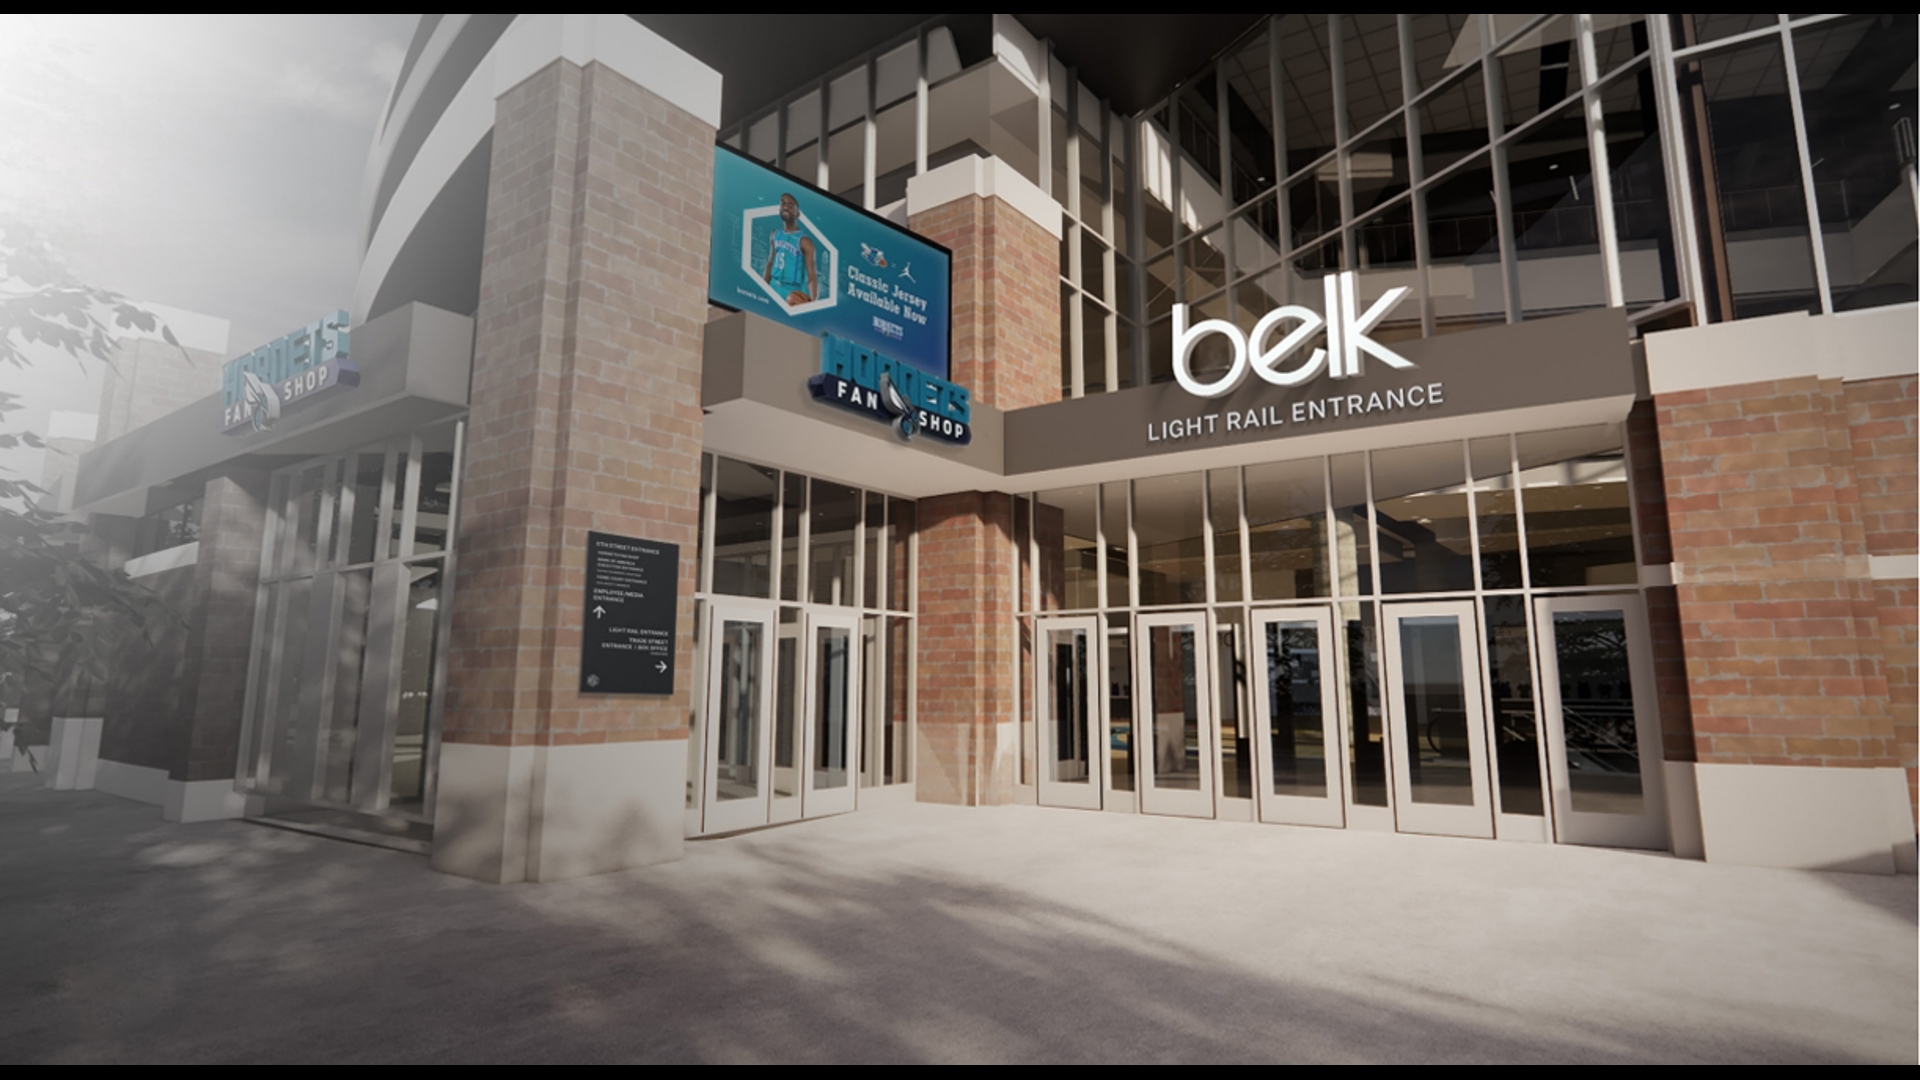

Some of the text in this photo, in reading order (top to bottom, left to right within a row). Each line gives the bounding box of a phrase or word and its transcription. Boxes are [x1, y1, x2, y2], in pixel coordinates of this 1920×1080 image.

[847, 281, 927, 325] Available Now
[848, 265, 927, 311] Classic Jersey
[1172, 270, 1418, 398] belk
[225, 366, 328, 426] FAN SHOP
[837, 380, 964, 439] FAN SHOP
[1148, 382, 1444, 442] LIGHT RAIL ENTRANCE
[631, 546, 660, 555] ENTRANCE
[593, 595, 625, 603] ENTRANCE
[601, 642, 632, 650] ENTRANCE
[639, 629, 669, 637] ENTRANCE
